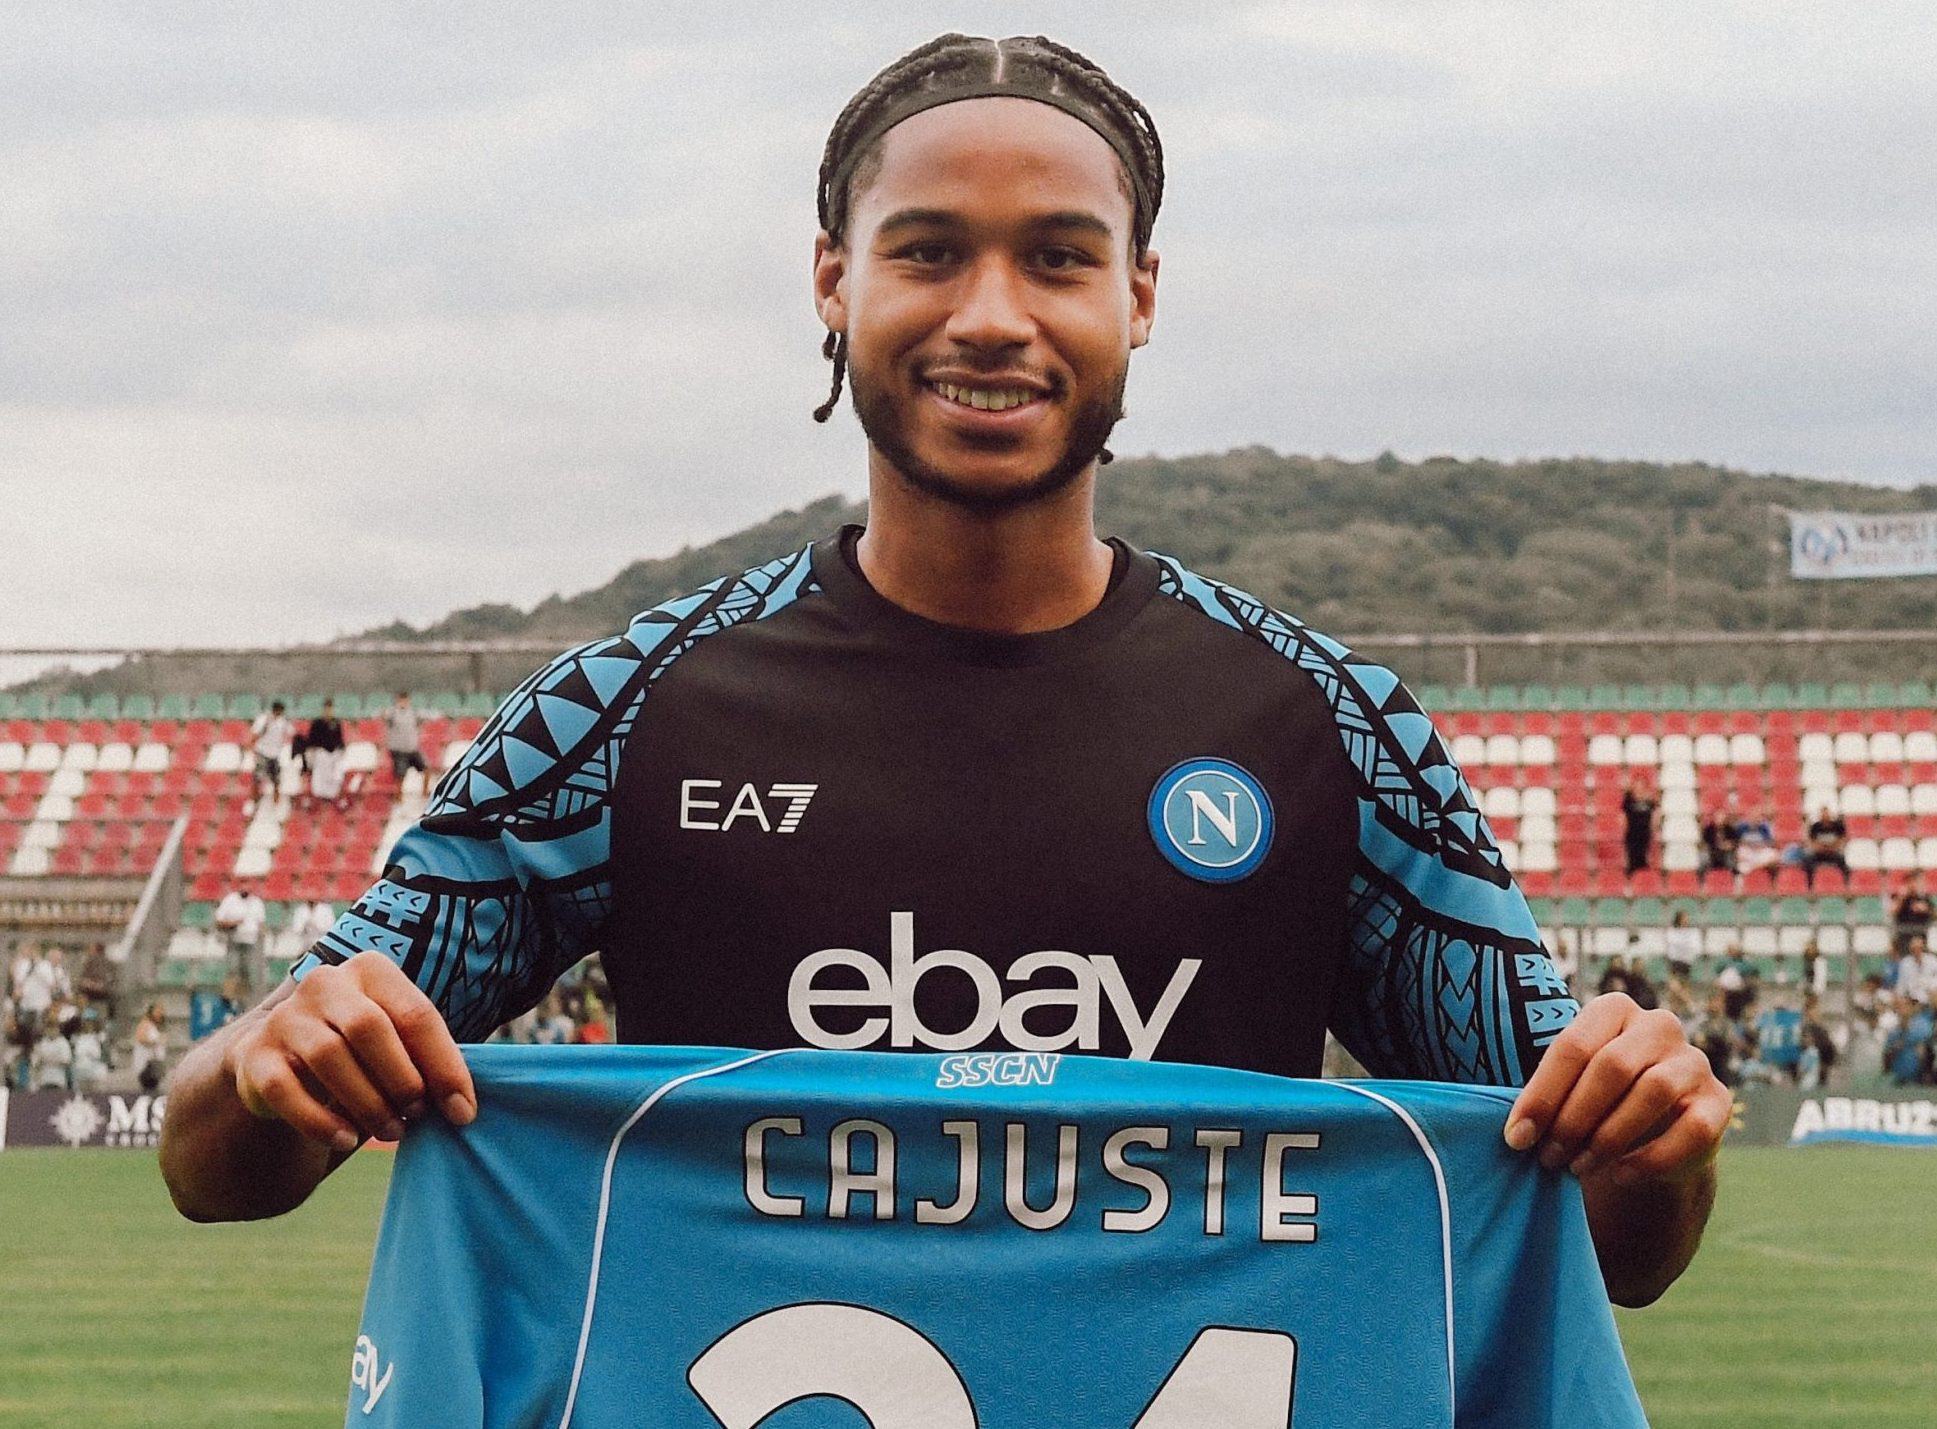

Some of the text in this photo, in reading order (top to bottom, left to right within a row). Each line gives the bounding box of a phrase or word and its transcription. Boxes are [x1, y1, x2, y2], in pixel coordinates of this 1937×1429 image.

[679, 778, 818, 833] EA7
[1186, 790, 1238, 847] N
[787, 911, 1203, 1060] ebay
[936, 1053, 1061, 1088] SSCN
[1791, 1097, 1937, 1141] ABRUZ
[743, 1116, 1322, 1243] CAJUSTE
[351, 1334, 394, 1414] ay
